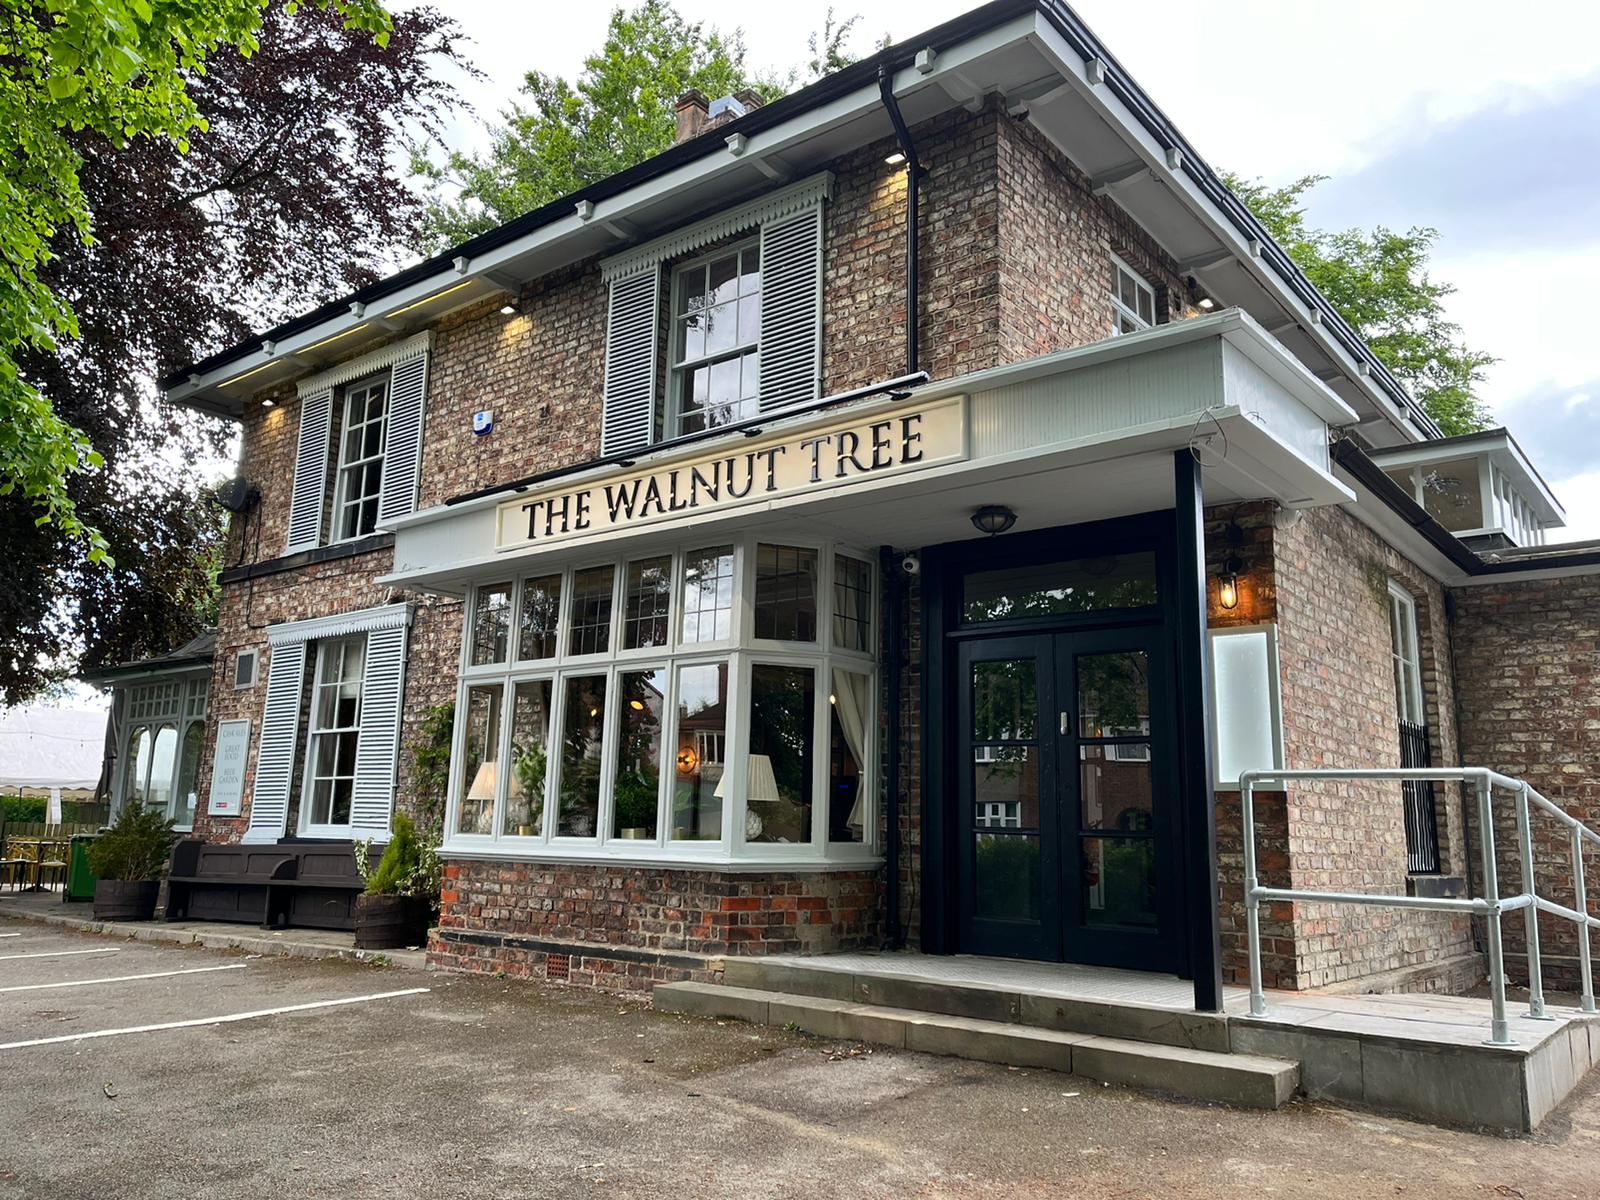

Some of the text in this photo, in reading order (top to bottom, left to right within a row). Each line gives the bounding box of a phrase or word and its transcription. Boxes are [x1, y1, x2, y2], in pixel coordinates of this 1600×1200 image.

[522, 414, 923, 539] THE WALNUT TREE
